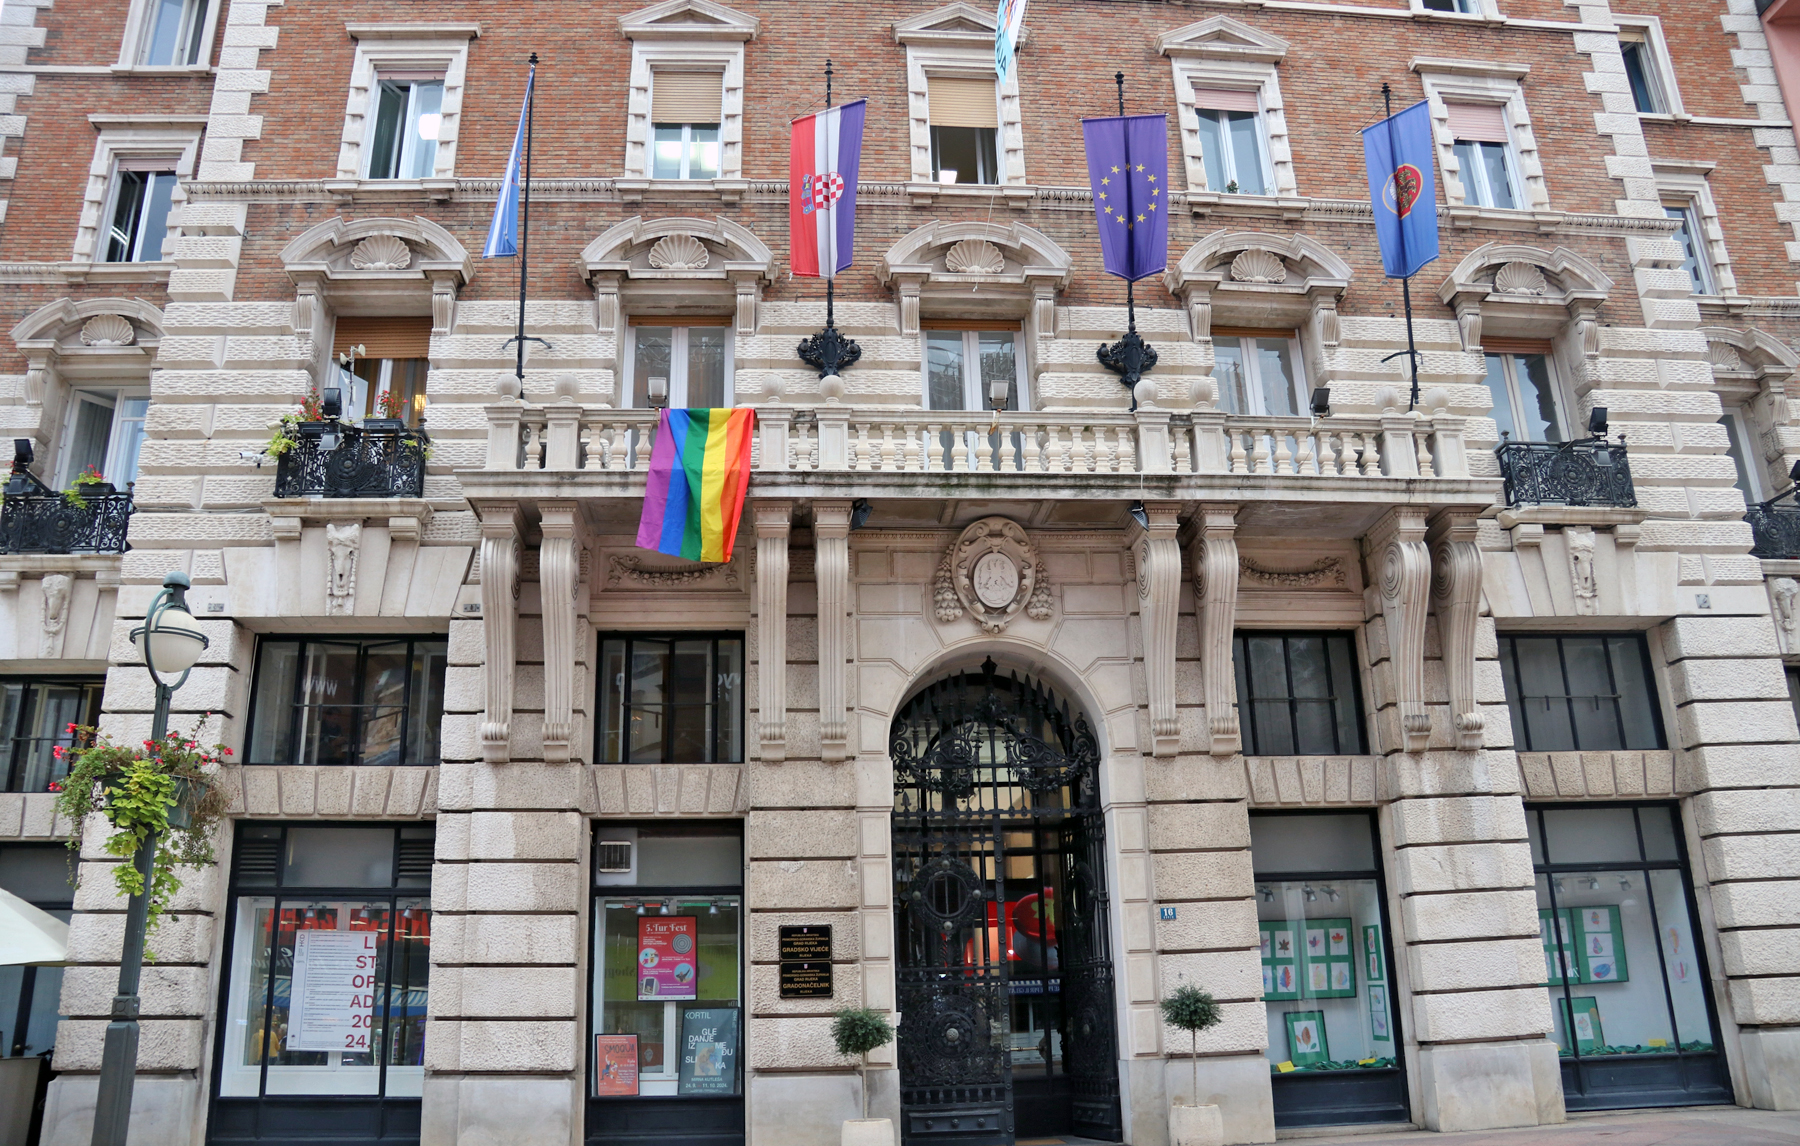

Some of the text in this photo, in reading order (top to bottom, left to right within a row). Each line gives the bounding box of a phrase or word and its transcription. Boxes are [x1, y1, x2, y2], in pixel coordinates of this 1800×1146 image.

[1163, 908, 1173, 916] 16
[669, 923, 688, 932] Fest
[355, 955, 376, 969] ST
[352, 974, 375, 989] OP
[349, 994, 374, 1008] AD
[351, 1014, 372, 1028] 20
[702, 1028, 717, 1036] GLE
[345, 1034, 371, 1048] 24.
